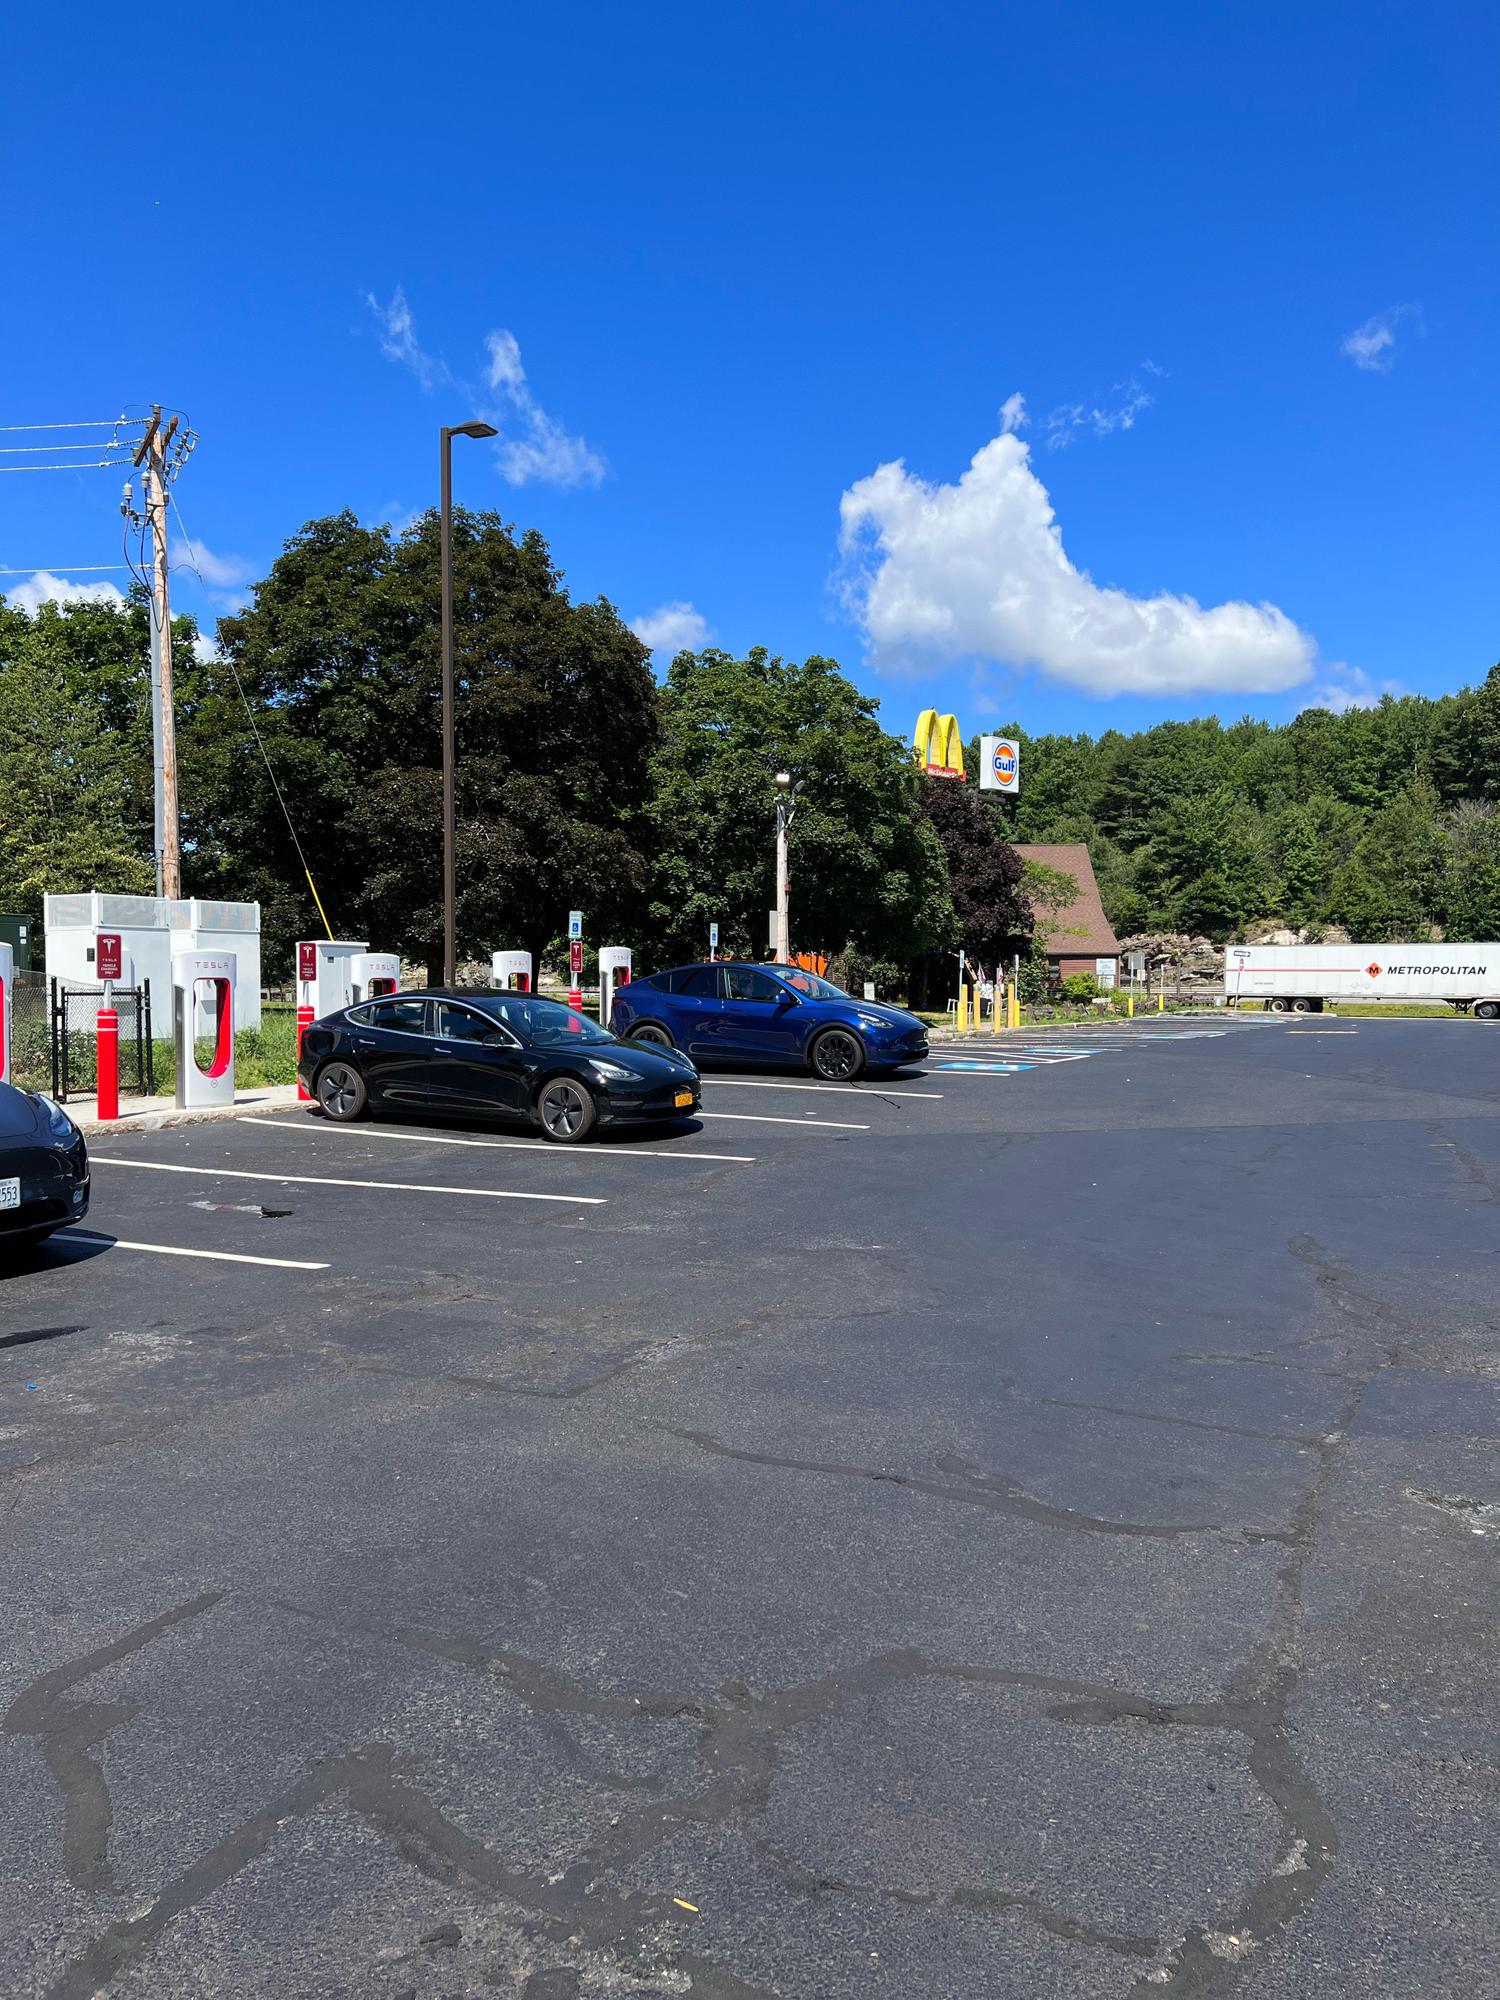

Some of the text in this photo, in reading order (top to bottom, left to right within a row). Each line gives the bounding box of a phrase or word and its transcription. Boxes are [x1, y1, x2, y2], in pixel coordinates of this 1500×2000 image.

[994, 757, 1016, 772] Gulf
[194, 961, 229, 969] TESLA
[1387, 966, 1488, 975] METROPOLITAN
[0, 1186, 17, 1202] 553
